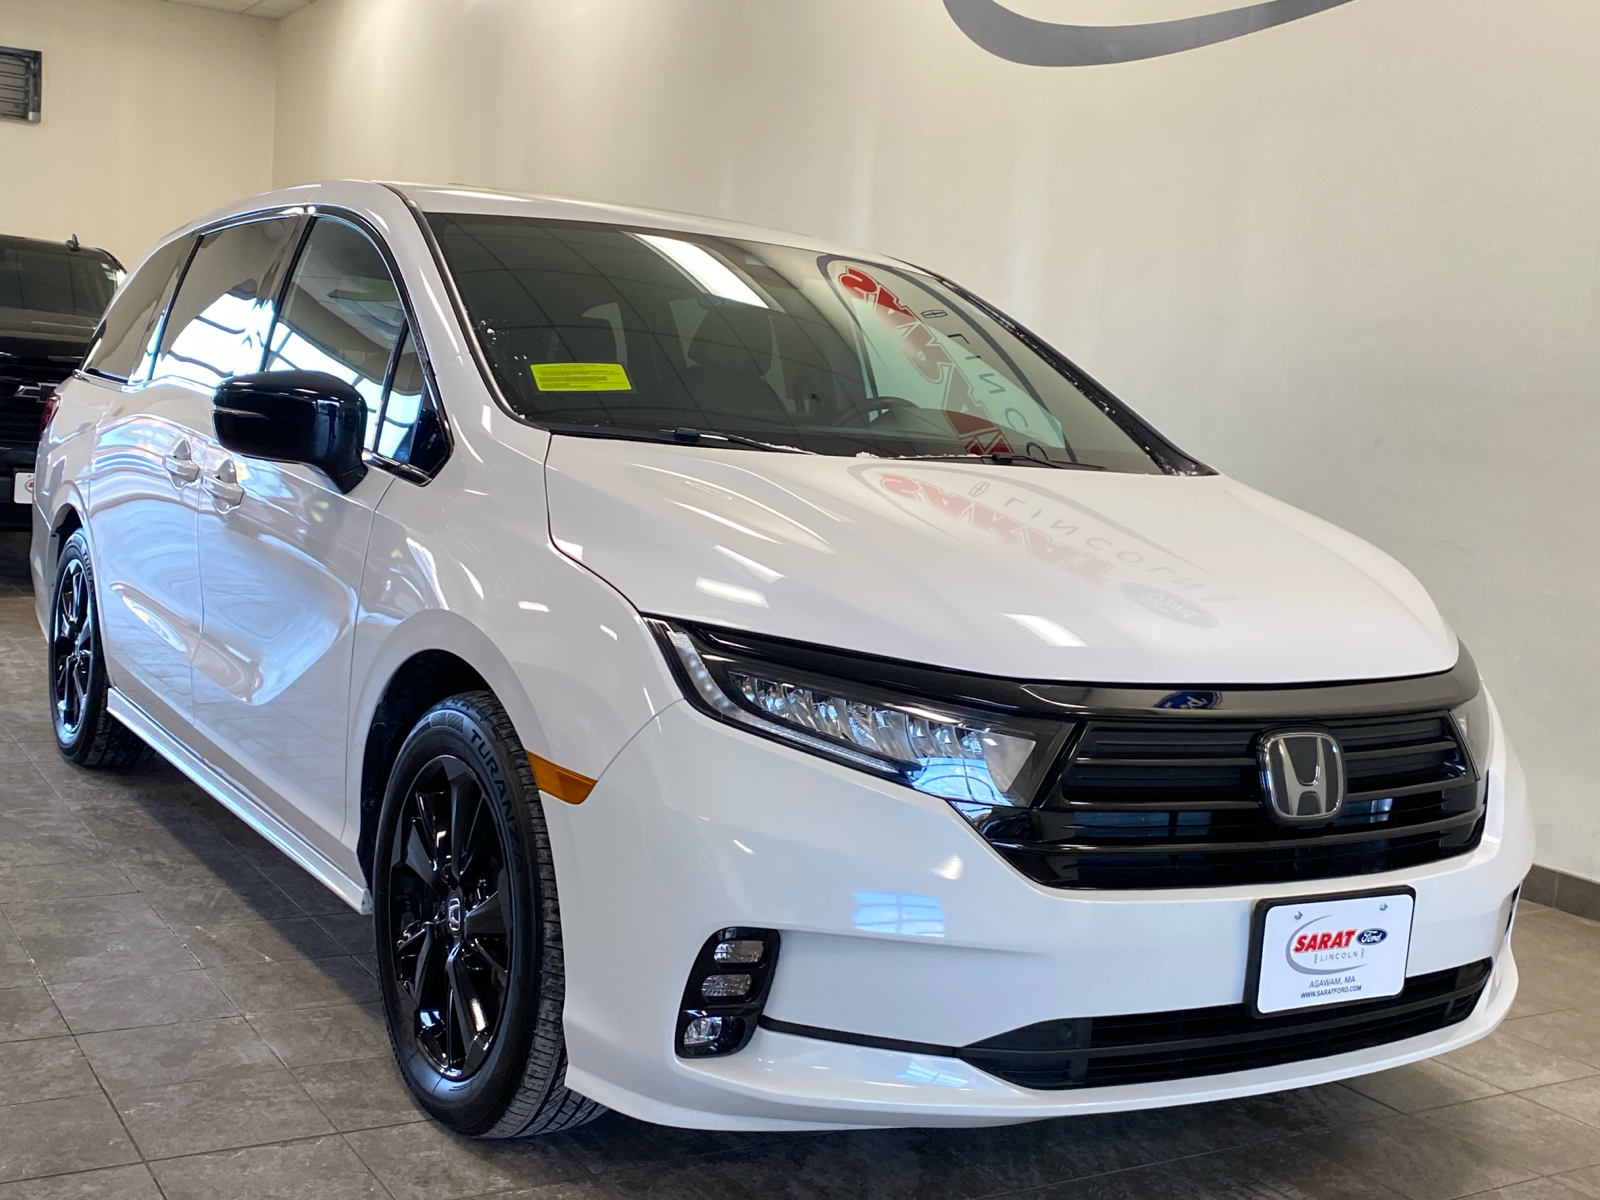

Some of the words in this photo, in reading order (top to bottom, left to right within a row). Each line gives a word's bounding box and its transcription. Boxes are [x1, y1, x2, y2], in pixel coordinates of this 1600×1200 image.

[1293, 929, 1357, 953] SARAT
[1360, 930, 1384, 944] Ford
[1320, 951, 1358, 961] LINCOLN
[1309, 977, 1343, 989] AGAWAM,
[1344, 976, 1356, 984] MA
[1301, 985, 1361, 998] WWW.SARATFORD.COM
